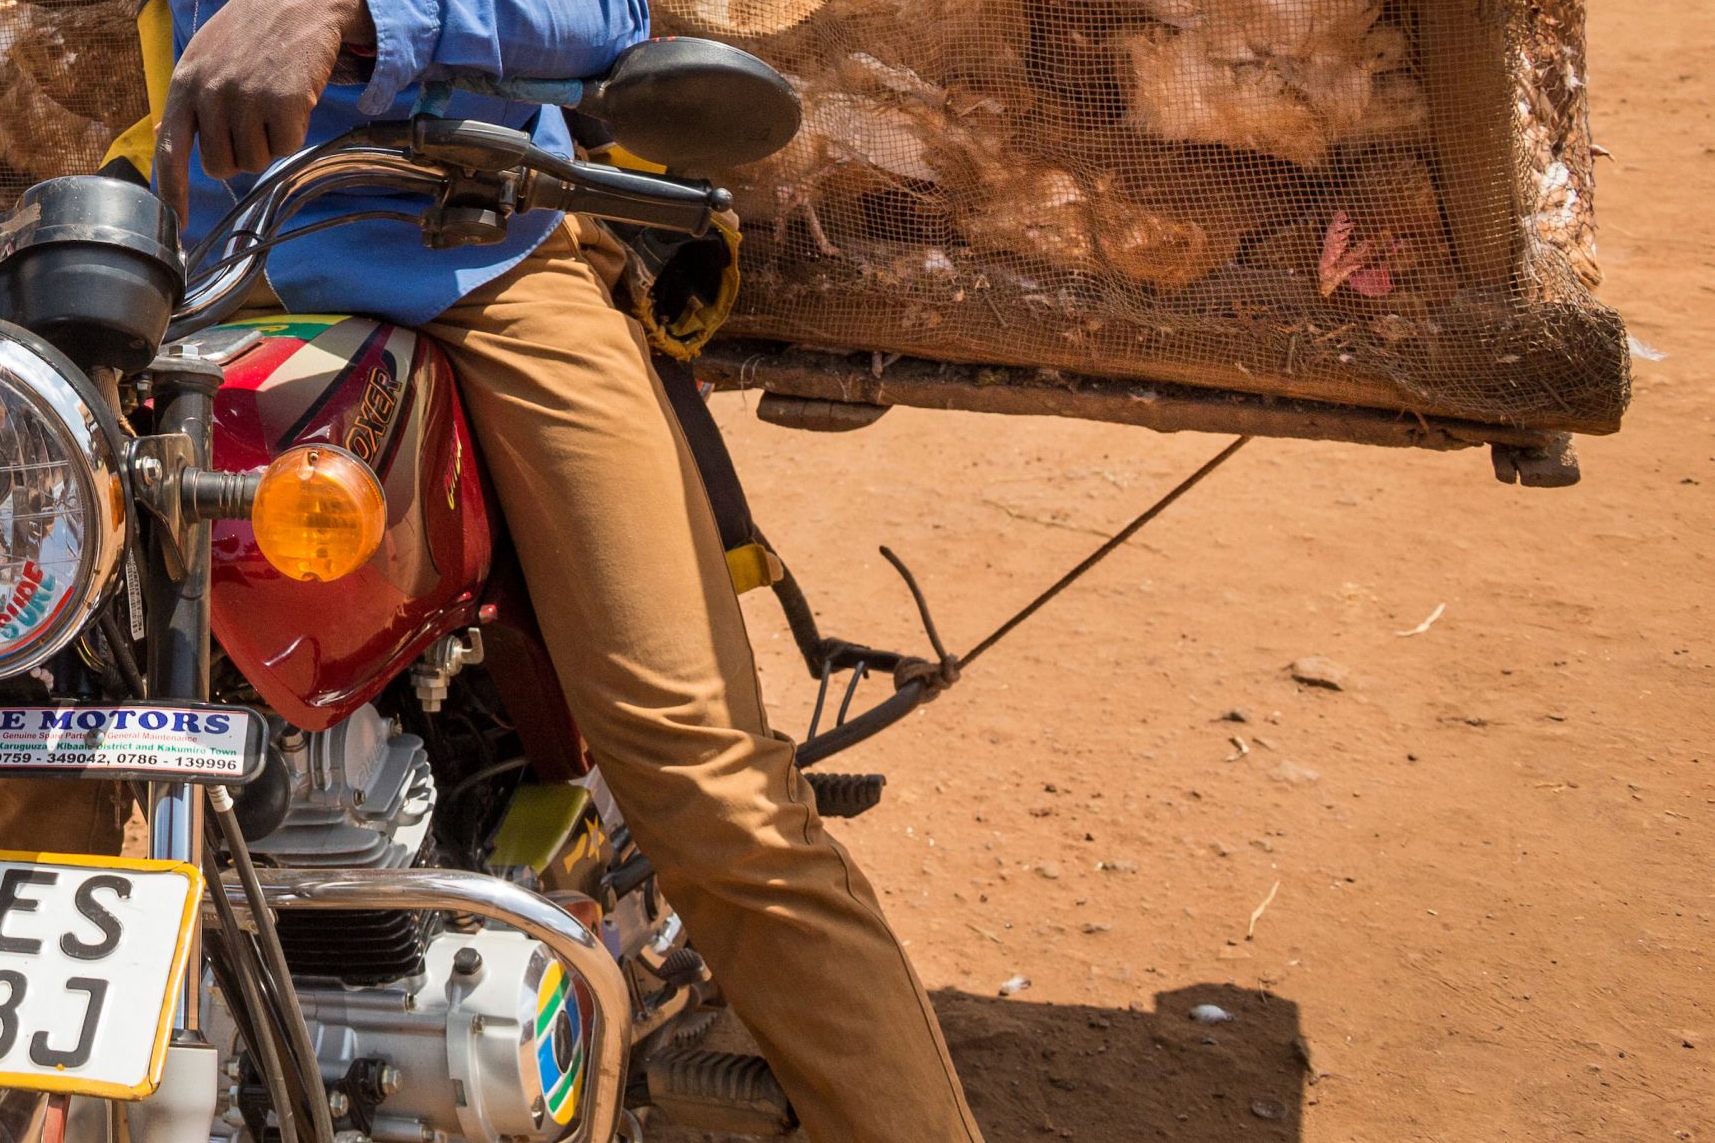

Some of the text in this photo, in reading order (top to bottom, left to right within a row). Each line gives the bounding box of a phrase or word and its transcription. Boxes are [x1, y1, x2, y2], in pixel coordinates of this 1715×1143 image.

[346, 367, 402, 465] OXER
[38, 710, 230, 735] MOTORS
[2, 731, 37, 739] Genuine
[39, 731, 63, 741] Spare
[135, 743, 154, 751] and
[157, 744, 206, 755] Kakumiro
[209, 747, 237, 756] Town
[46, 753, 111, 766] 349042,
[117, 753, 158, 765] 0786
[175, 756, 237, 770] 139996
